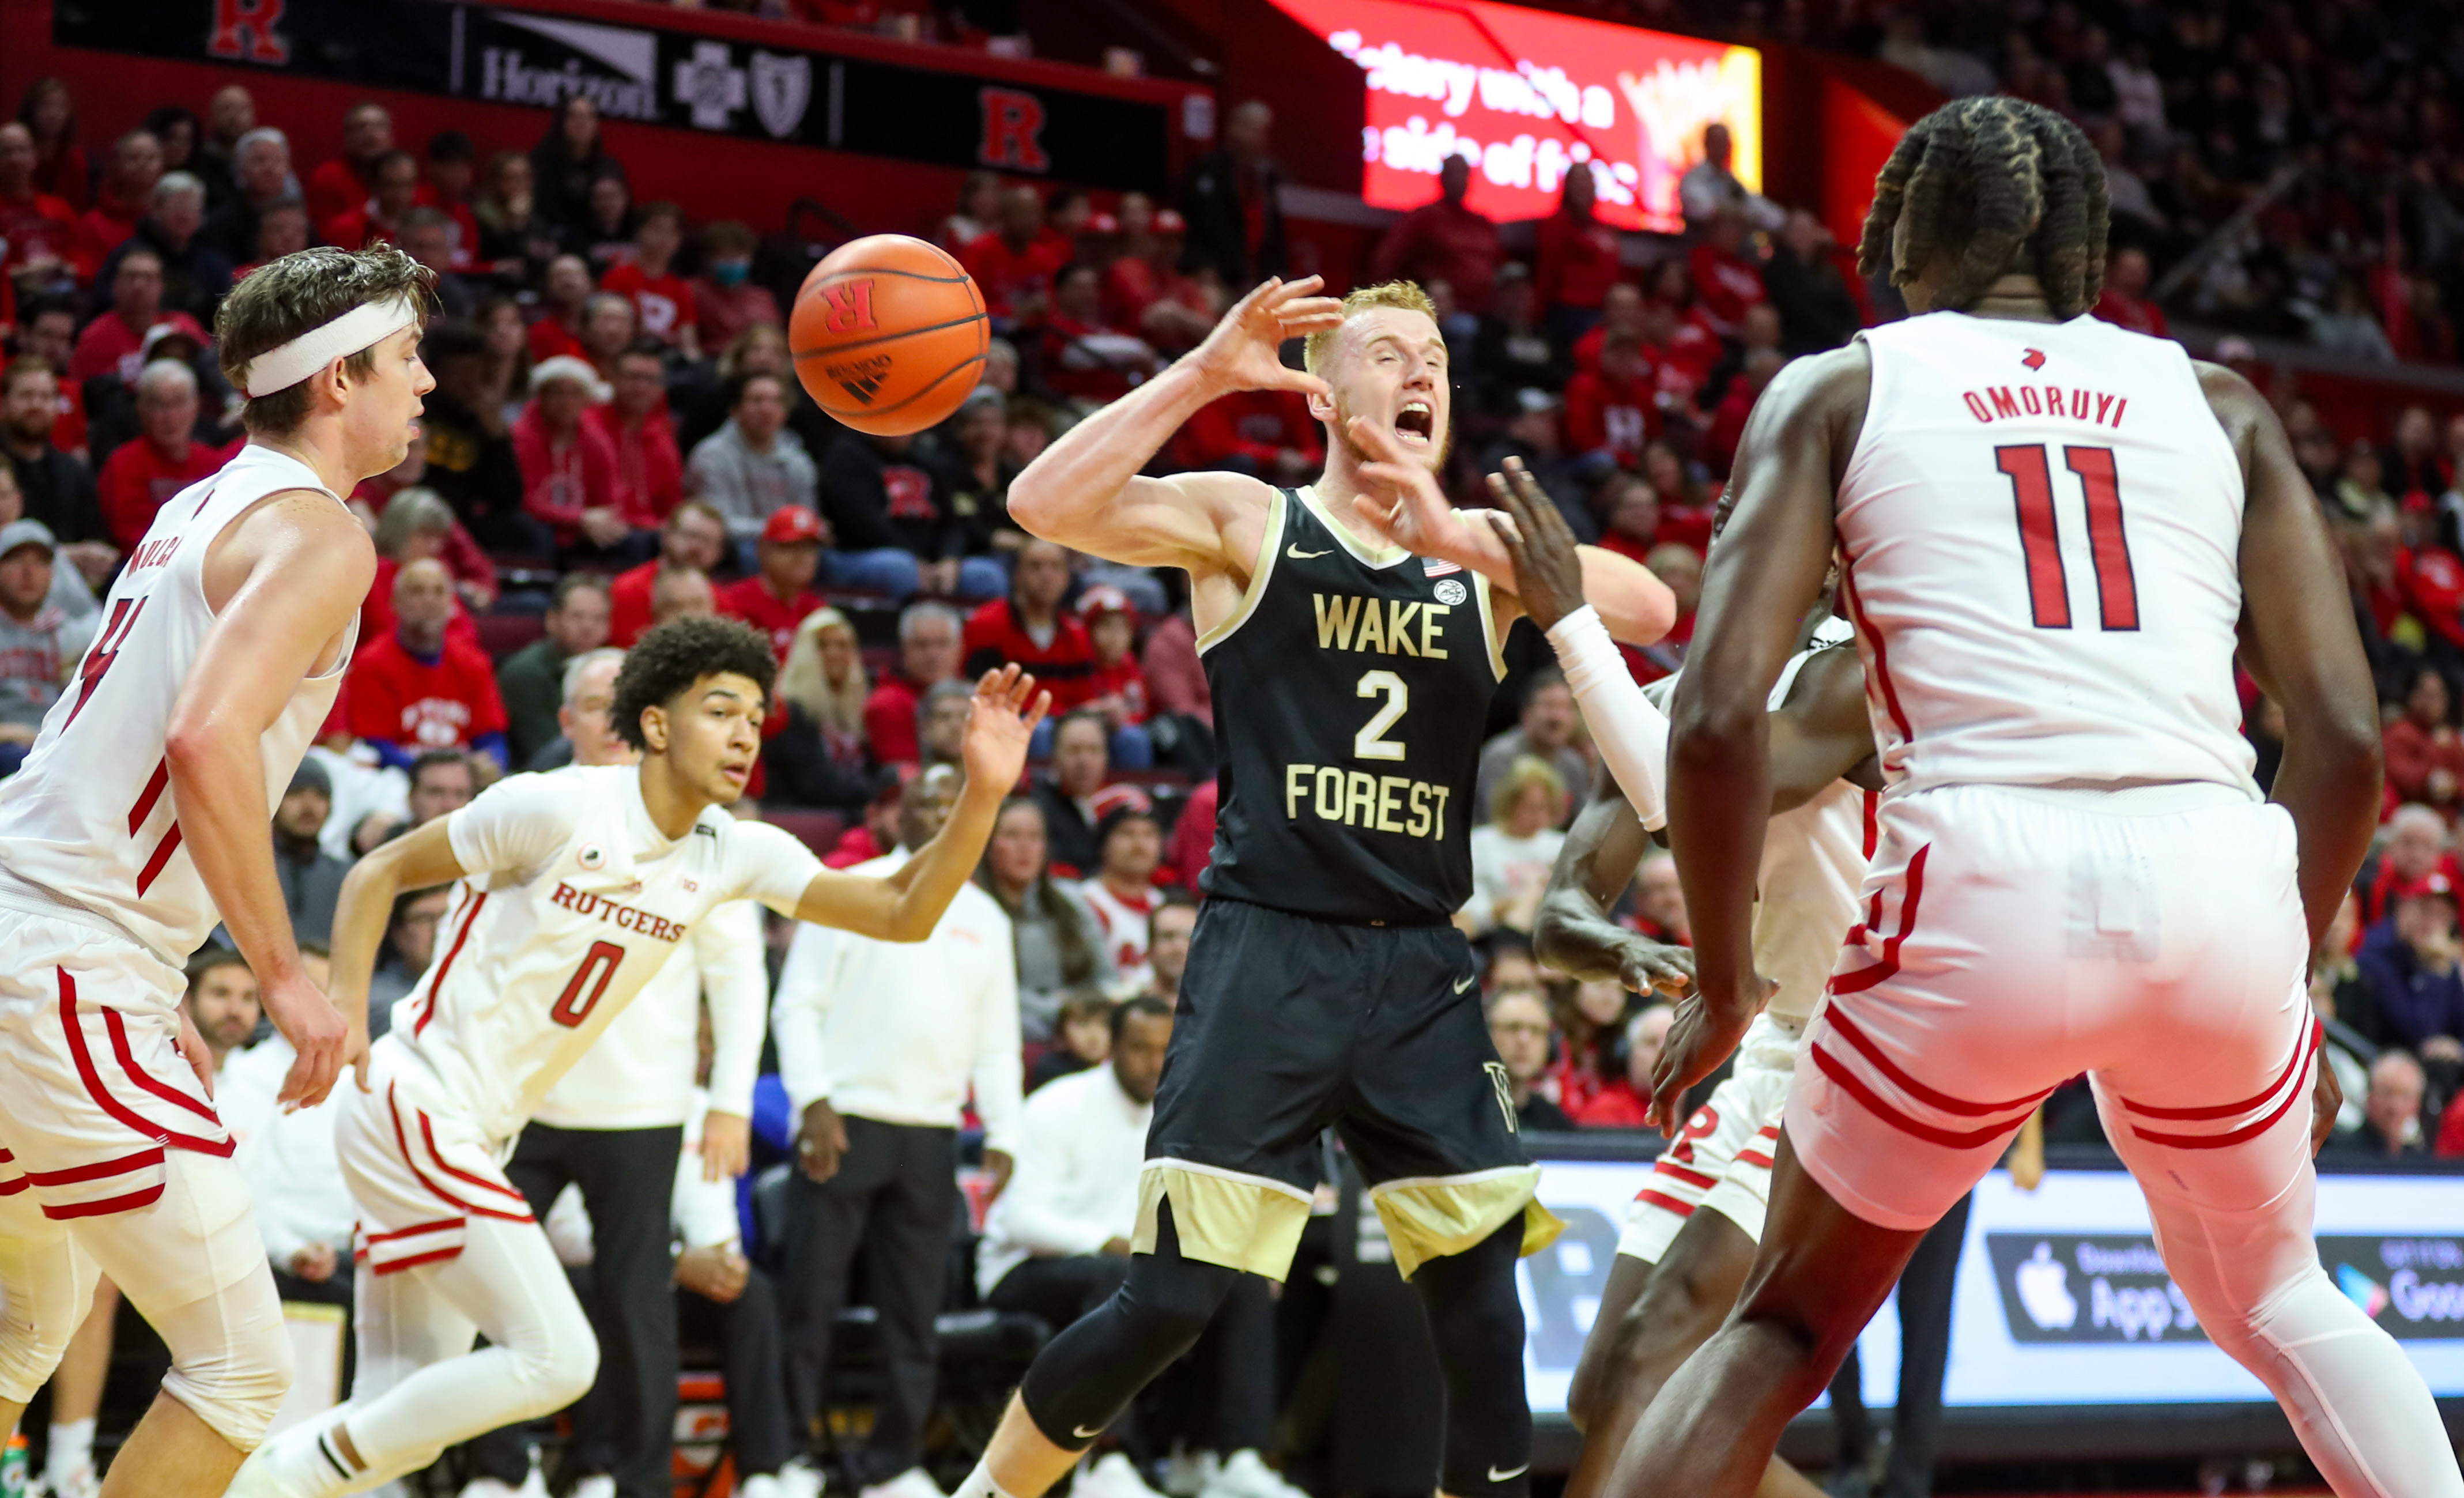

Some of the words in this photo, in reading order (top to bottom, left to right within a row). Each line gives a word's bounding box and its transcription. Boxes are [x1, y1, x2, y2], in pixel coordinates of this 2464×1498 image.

[209, 0, 290, 64] R
[483, 46, 656, 119] Horizon
[979, 87, 1048, 173] R
[1962, 385, 2128, 429] OMORUYI
[1993, 443, 2141, 632] 11
[1312, 593, 1451, 660] WAKE
[1354, 669, 1408, 761] 2
[1285, 763, 1450, 842] FOREST
[550, 881, 688, 943] RUTGERS
[550, 940, 625, 1029] 0
[2091, 1276, 2172, 1342] App
